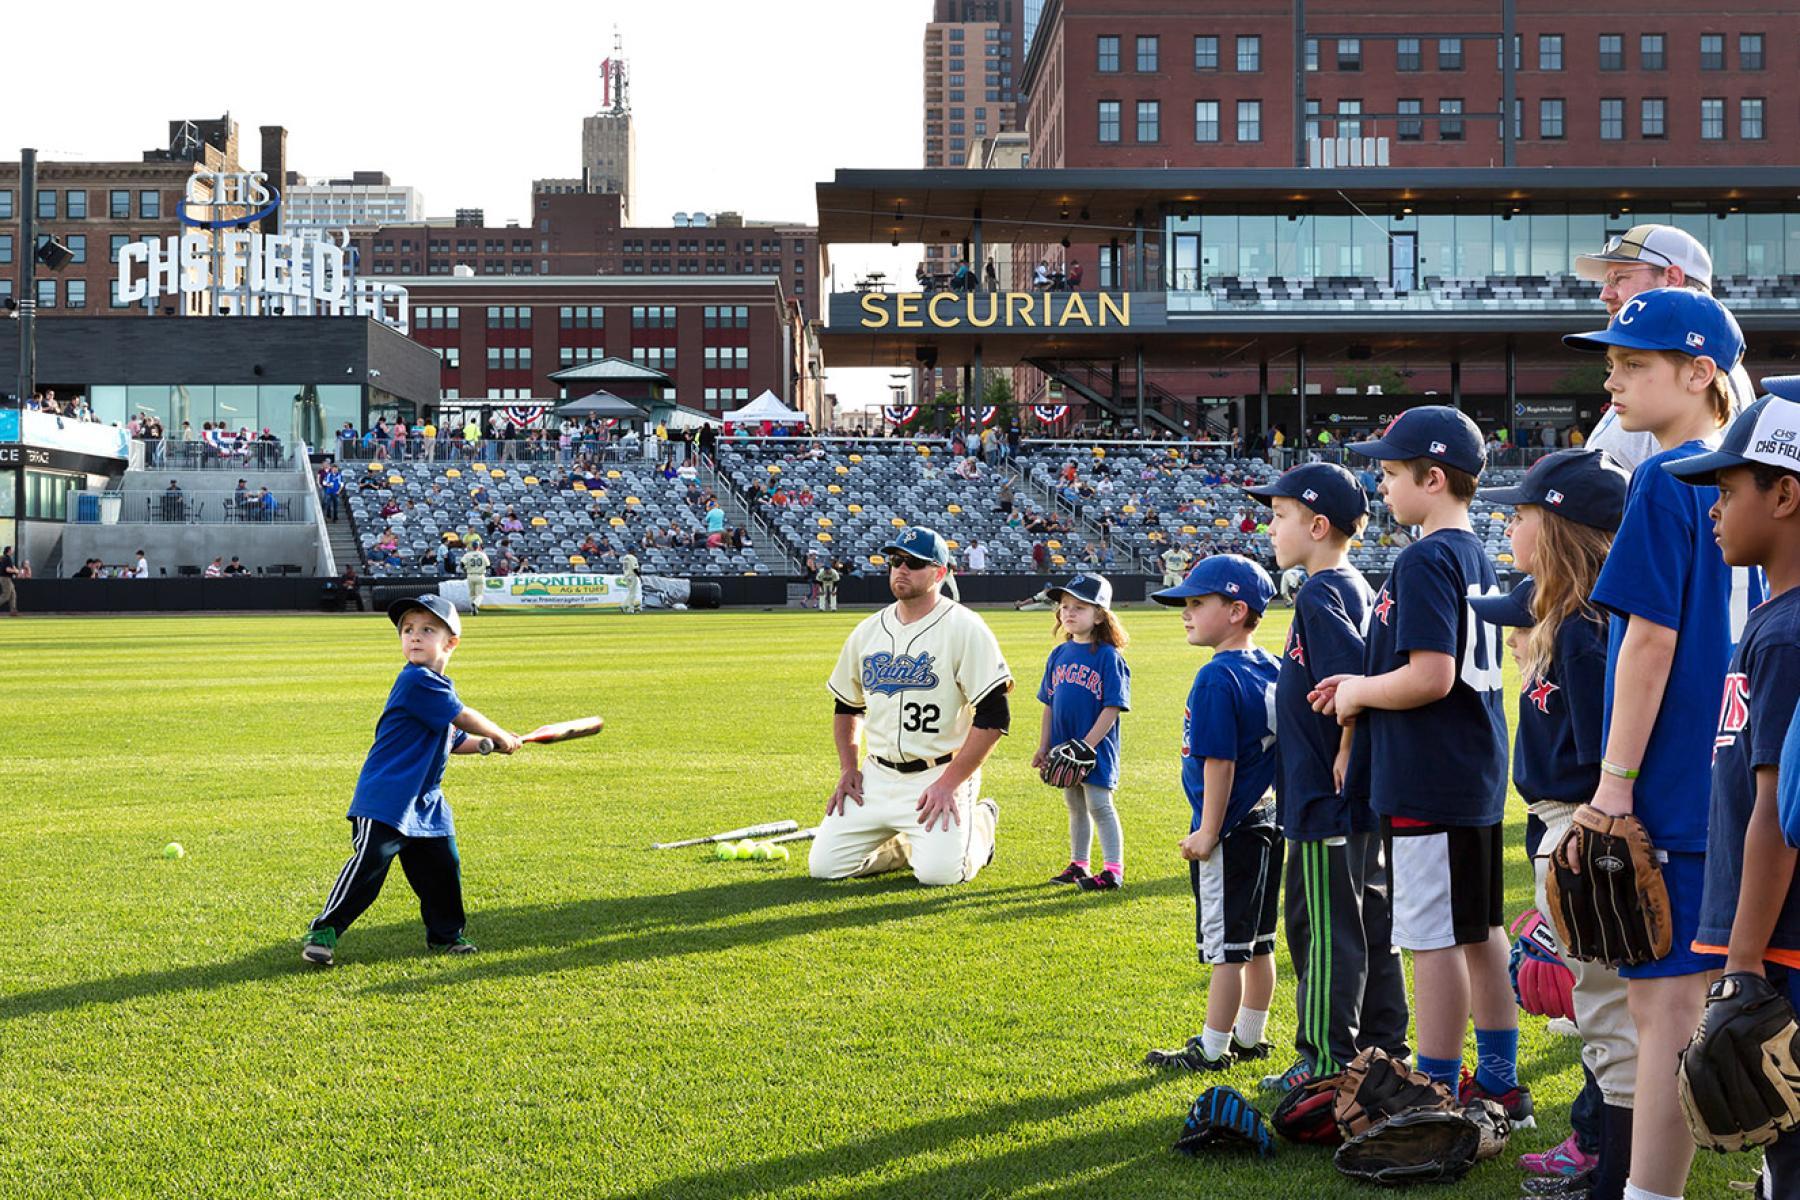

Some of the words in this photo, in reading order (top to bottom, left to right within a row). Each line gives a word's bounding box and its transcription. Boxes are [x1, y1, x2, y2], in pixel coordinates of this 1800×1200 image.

[186, 172, 271, 206] CHS
[118, 234, 210, 302] CHS
[222, 232, 344, 302] FIELD
[861, 292, 1130, 327] SECURIAN
[1379, 413, 1399, 424] SA
[1755, 440, 1777, 454] CHS
[513, 576, 605, 586] FRONTIER
[863, 651, 938, 693] Saints
[903, 702, 940, 734] 32
